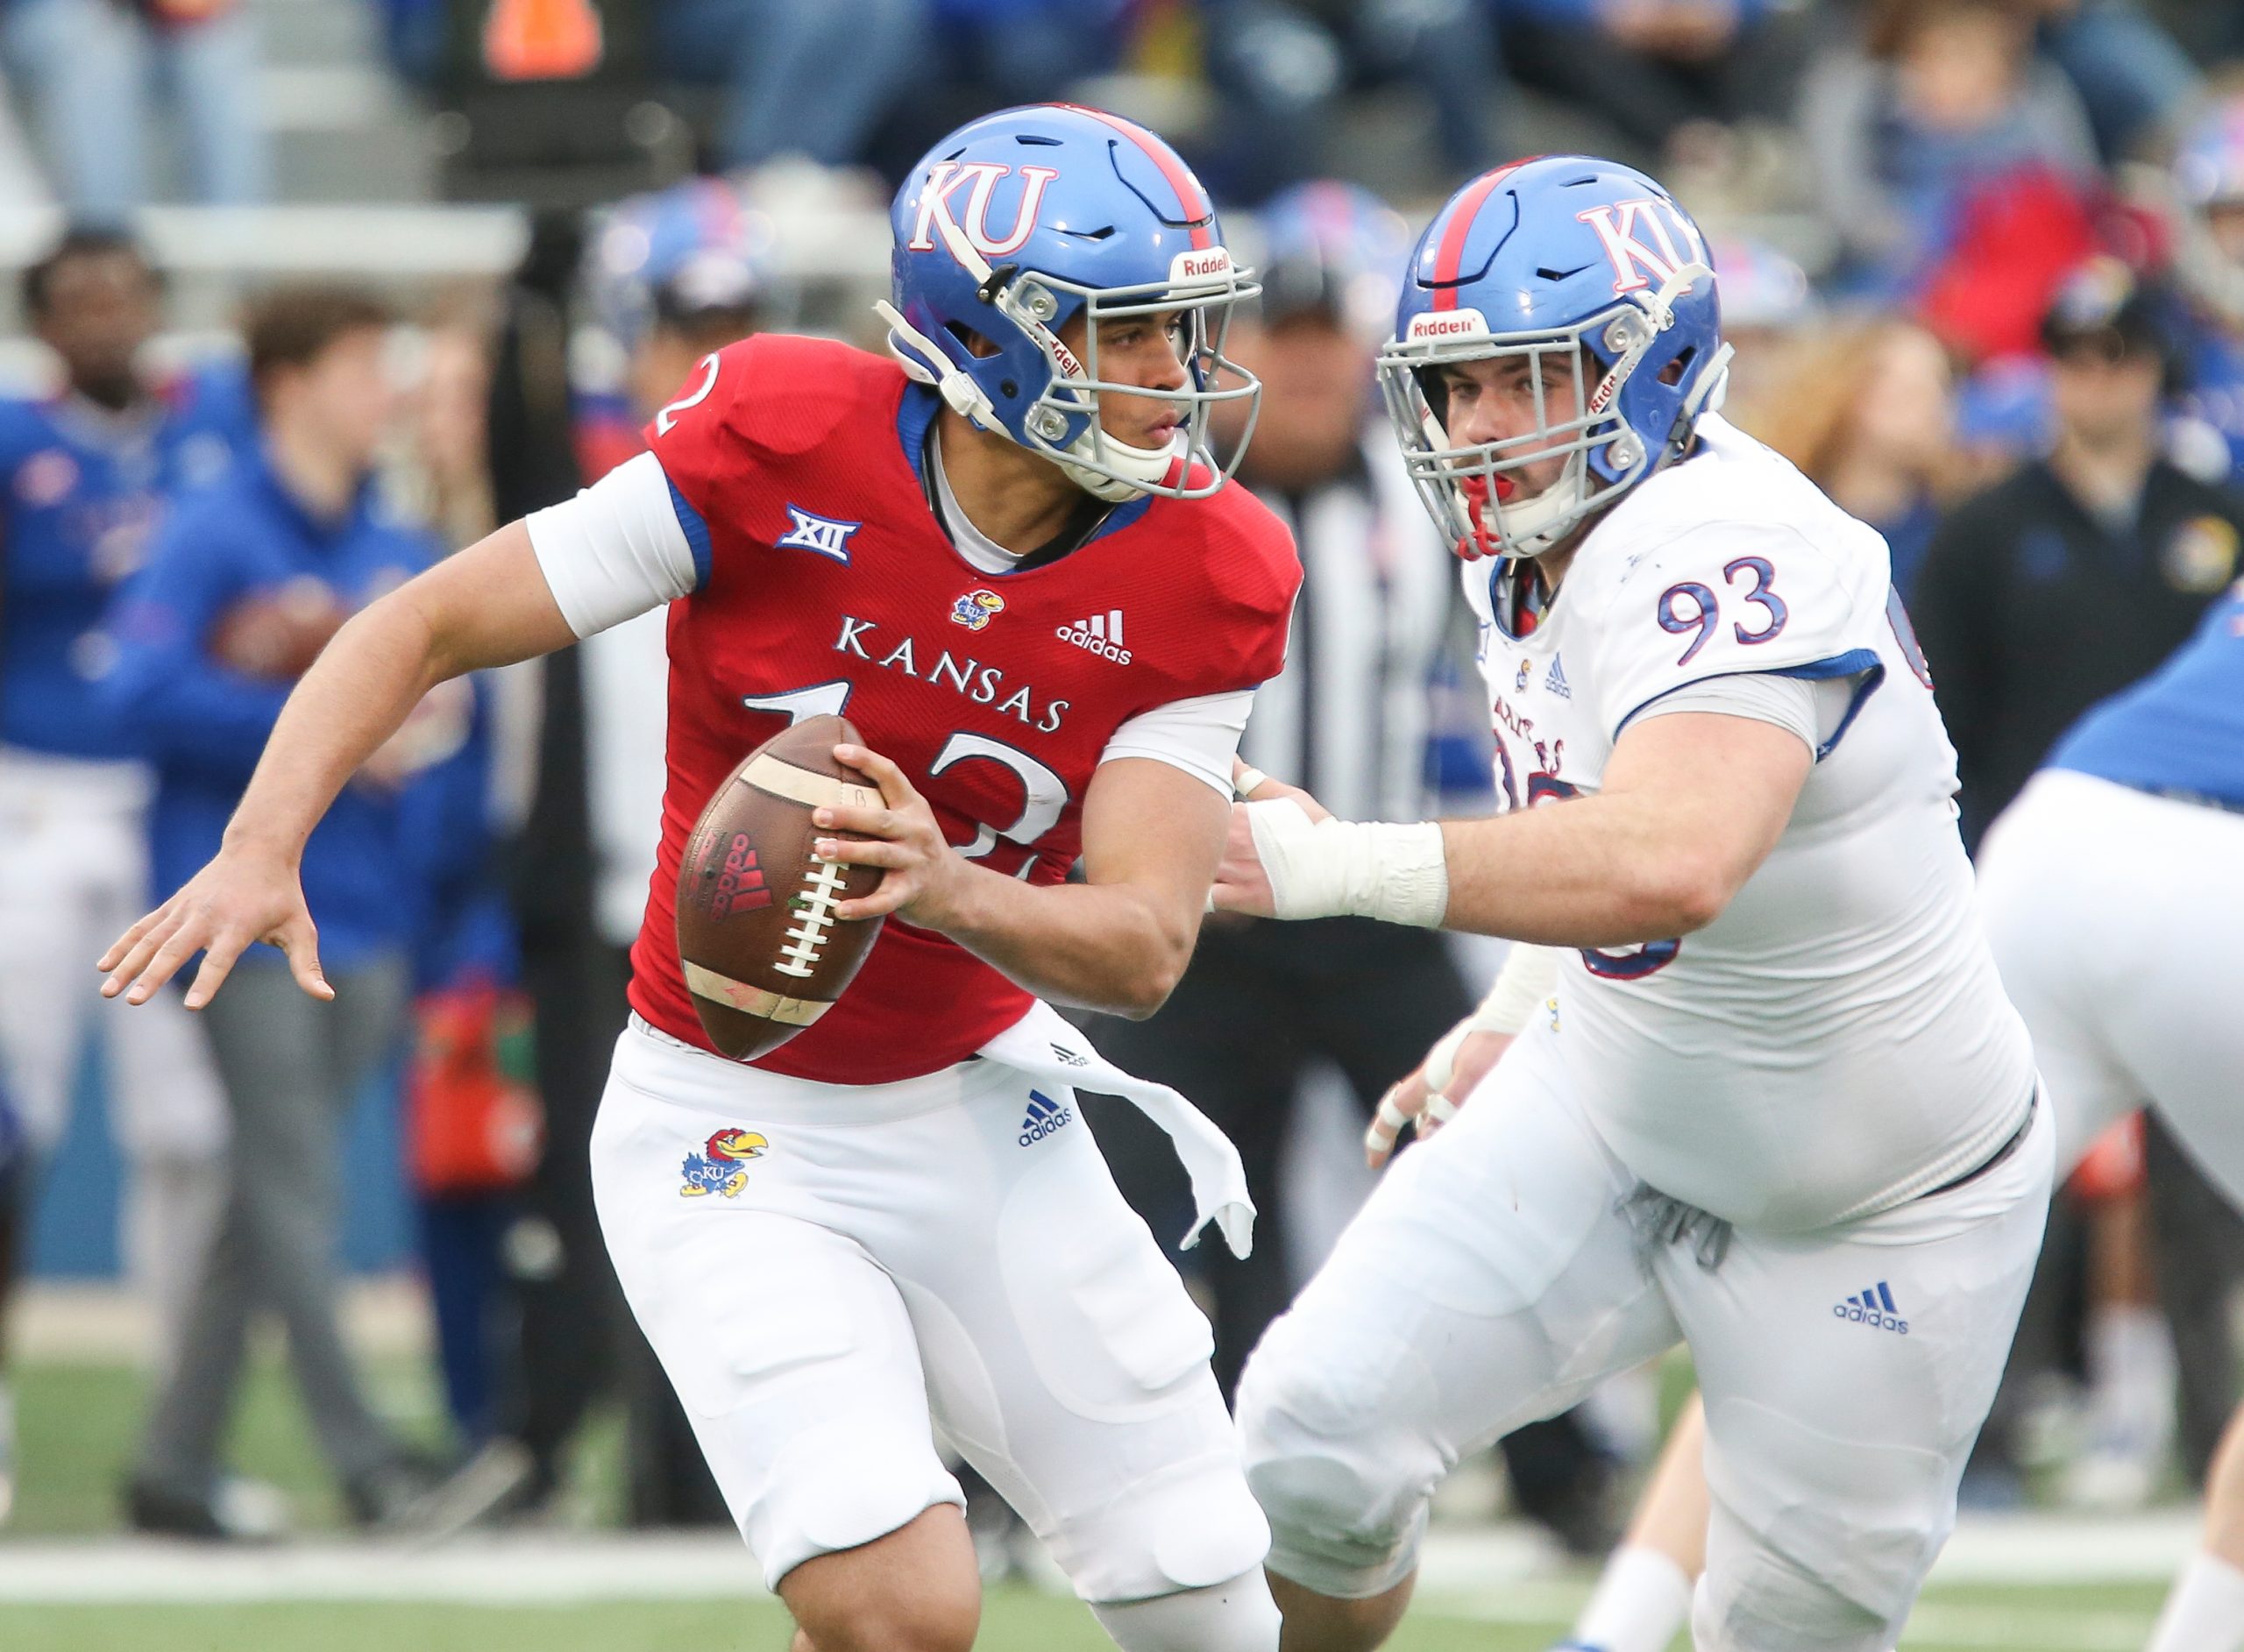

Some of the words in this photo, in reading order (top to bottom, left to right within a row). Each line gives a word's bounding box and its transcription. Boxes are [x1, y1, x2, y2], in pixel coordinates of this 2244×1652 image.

[908, 160, 1059, 266] KU
[1184, 252, 1229, 276] Riddell
[1575, 199, 1701, 295] KU
[1414, 319, 1472, 337] Riddell
[1658, 556, 1788, 666] 93
[1056, 621, 1133, 666] adidas
[833, 615, 1071, 734] KANSAS
[1019, 1107, 1072, 1148] adidas
[702, 1166, 725, 1181] KU
[1834, 1305, 1908, 1335] adidas
